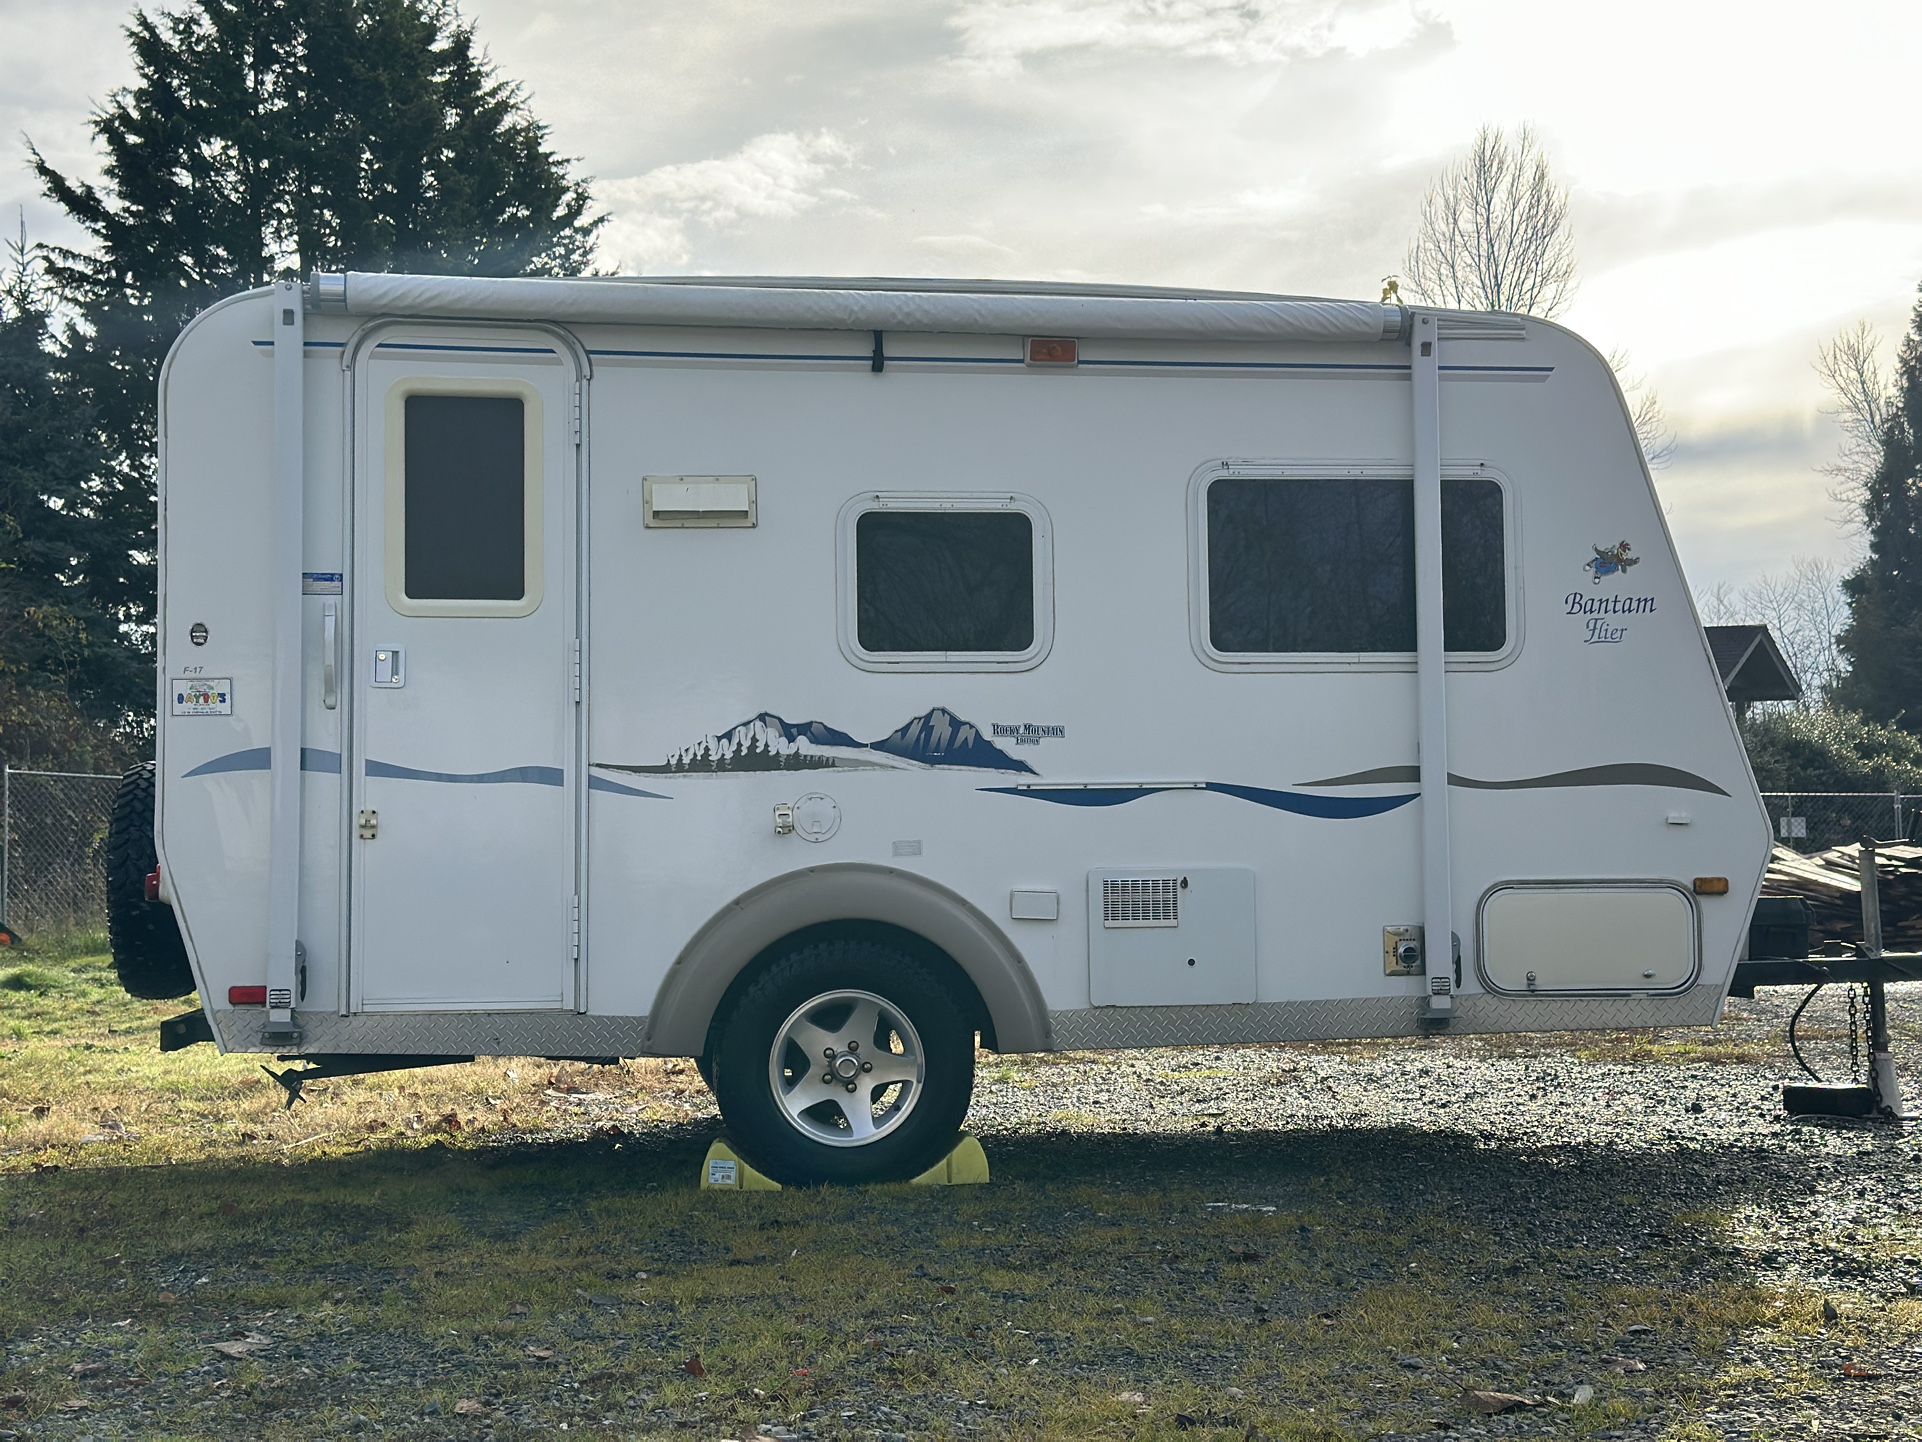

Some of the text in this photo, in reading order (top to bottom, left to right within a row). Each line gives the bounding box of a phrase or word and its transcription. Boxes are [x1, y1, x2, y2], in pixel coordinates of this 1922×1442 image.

[1565, 592, 1657, 615] Bantam
[1584, 617, 1628, 644] Flier
[183, 666, 204, 674] F-17
